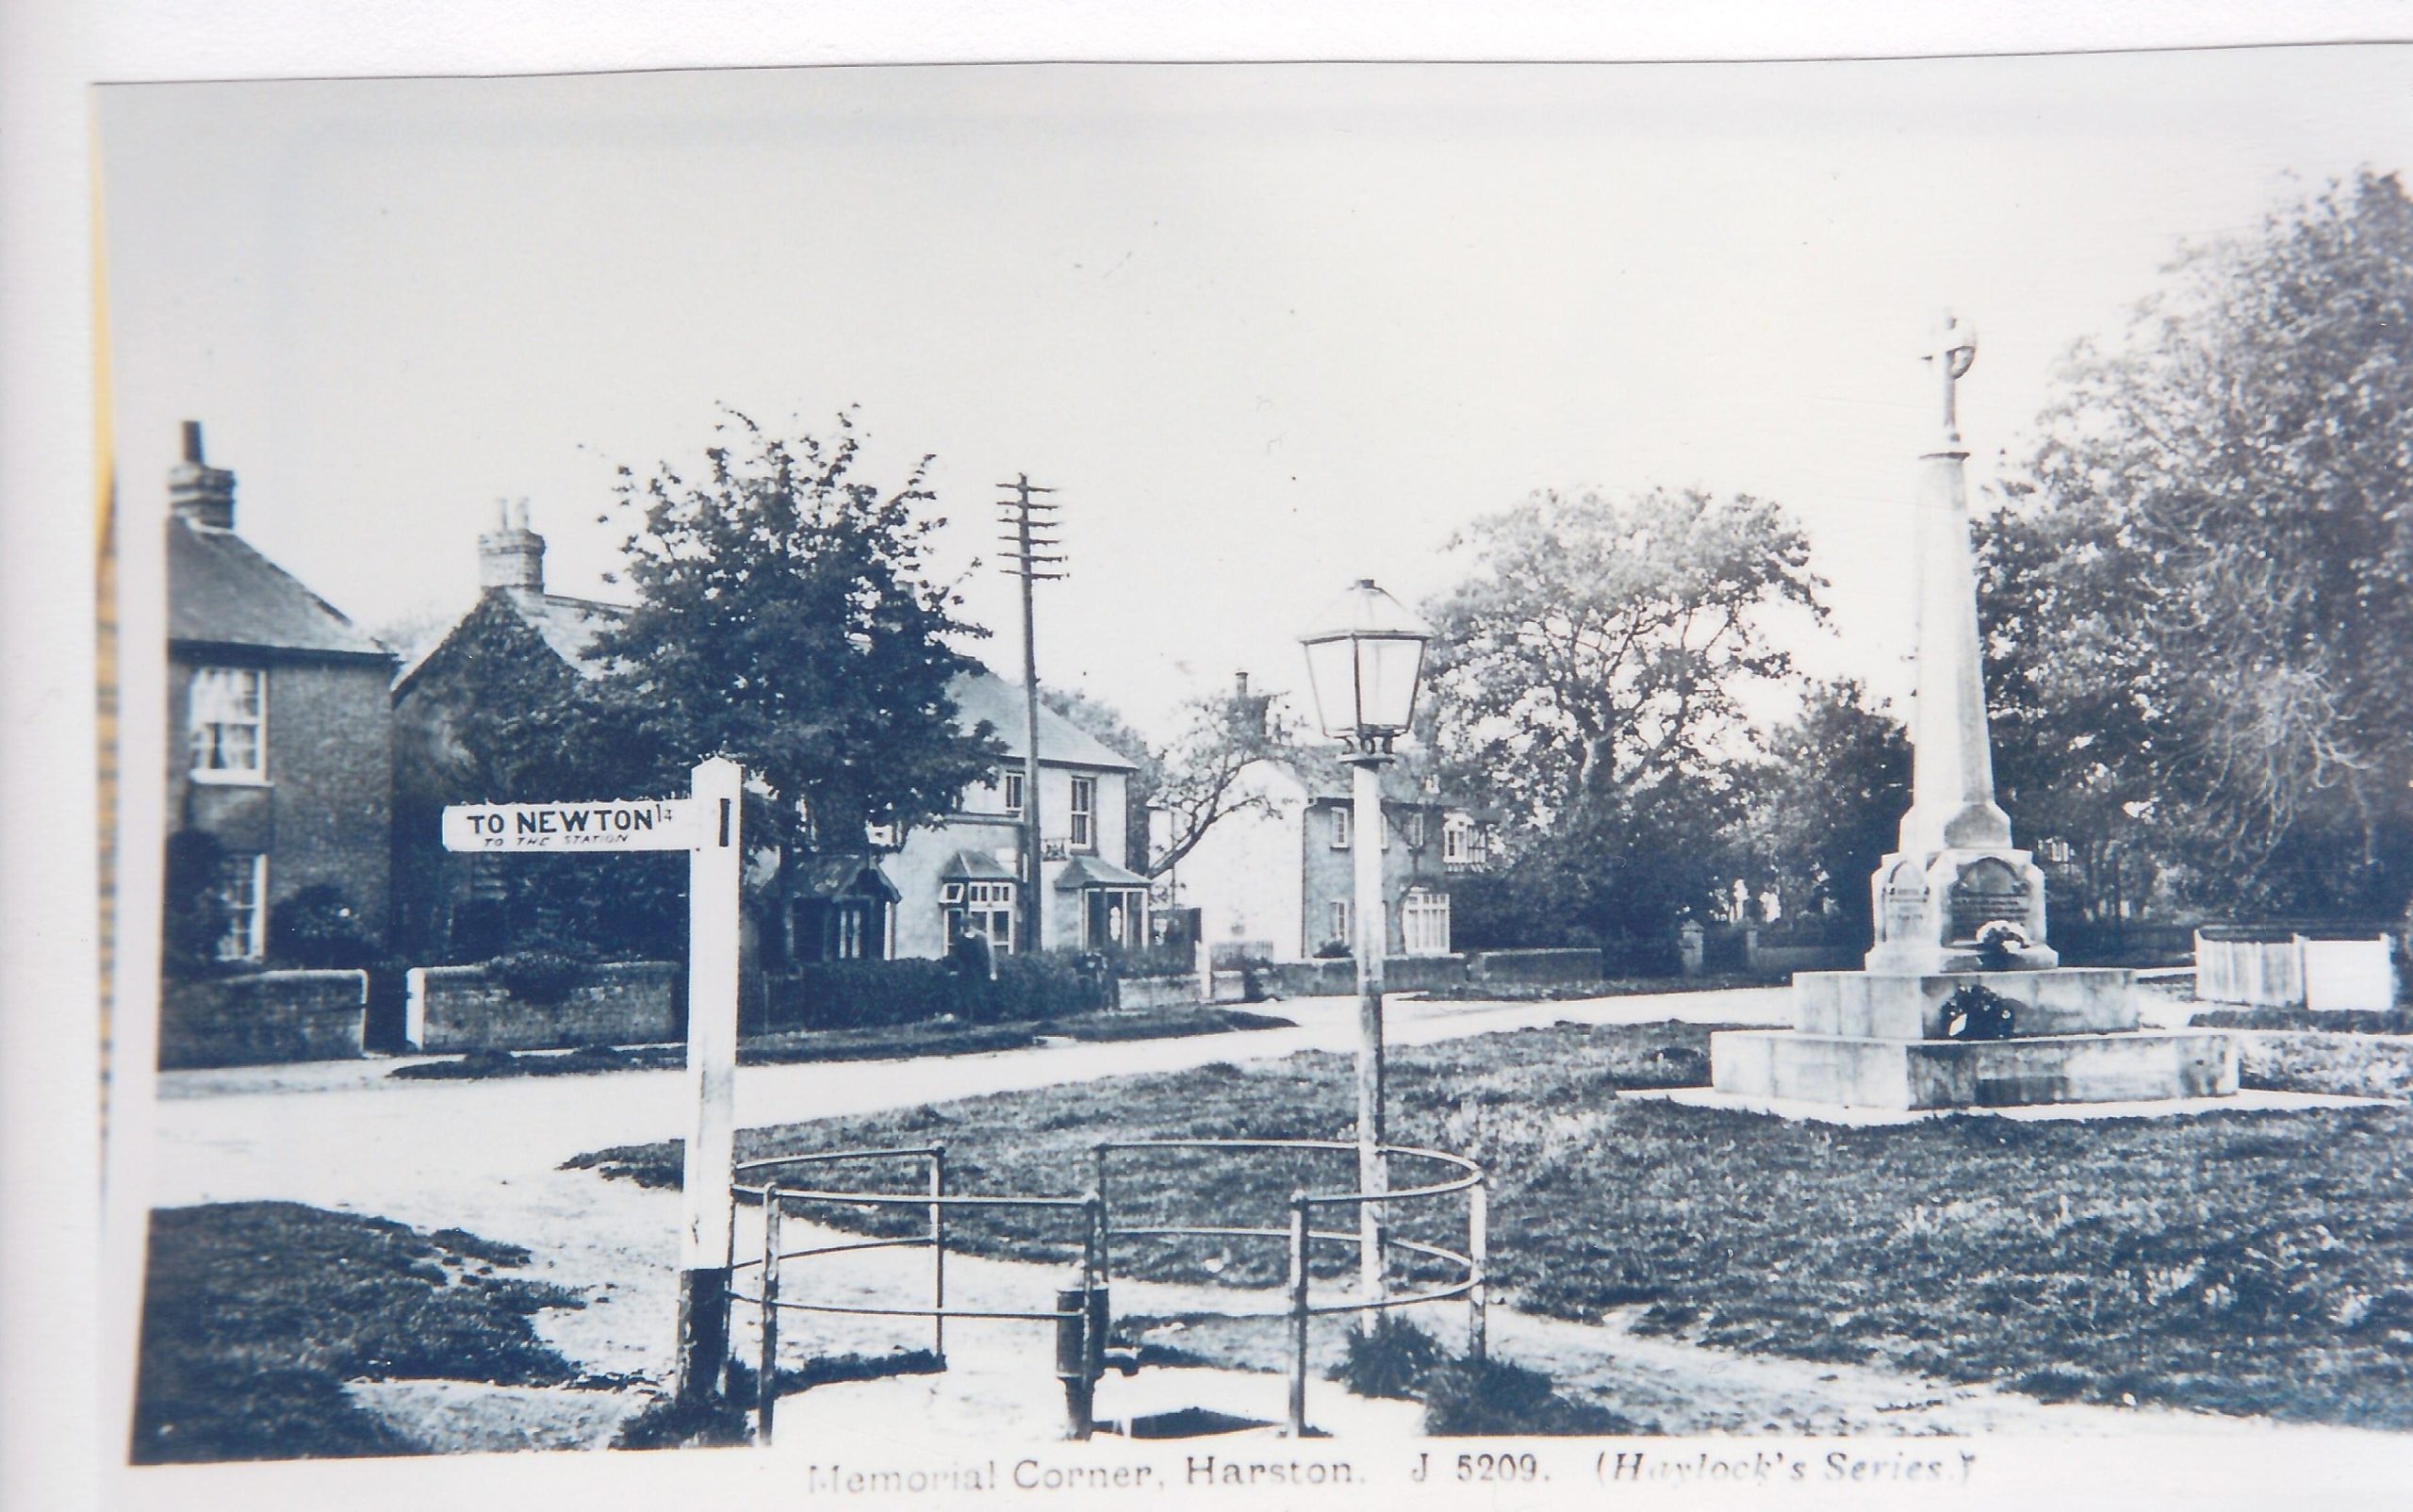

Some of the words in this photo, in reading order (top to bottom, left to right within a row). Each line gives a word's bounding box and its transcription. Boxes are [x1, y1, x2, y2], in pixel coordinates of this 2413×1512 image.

[466, 814, 505, 834] TO
[516, 809, 653, 834] NEWTON
[483, 837, 504, 847] TO
[517, 836, 550, 846] THE
[564, 834, 630, 845] STATION
